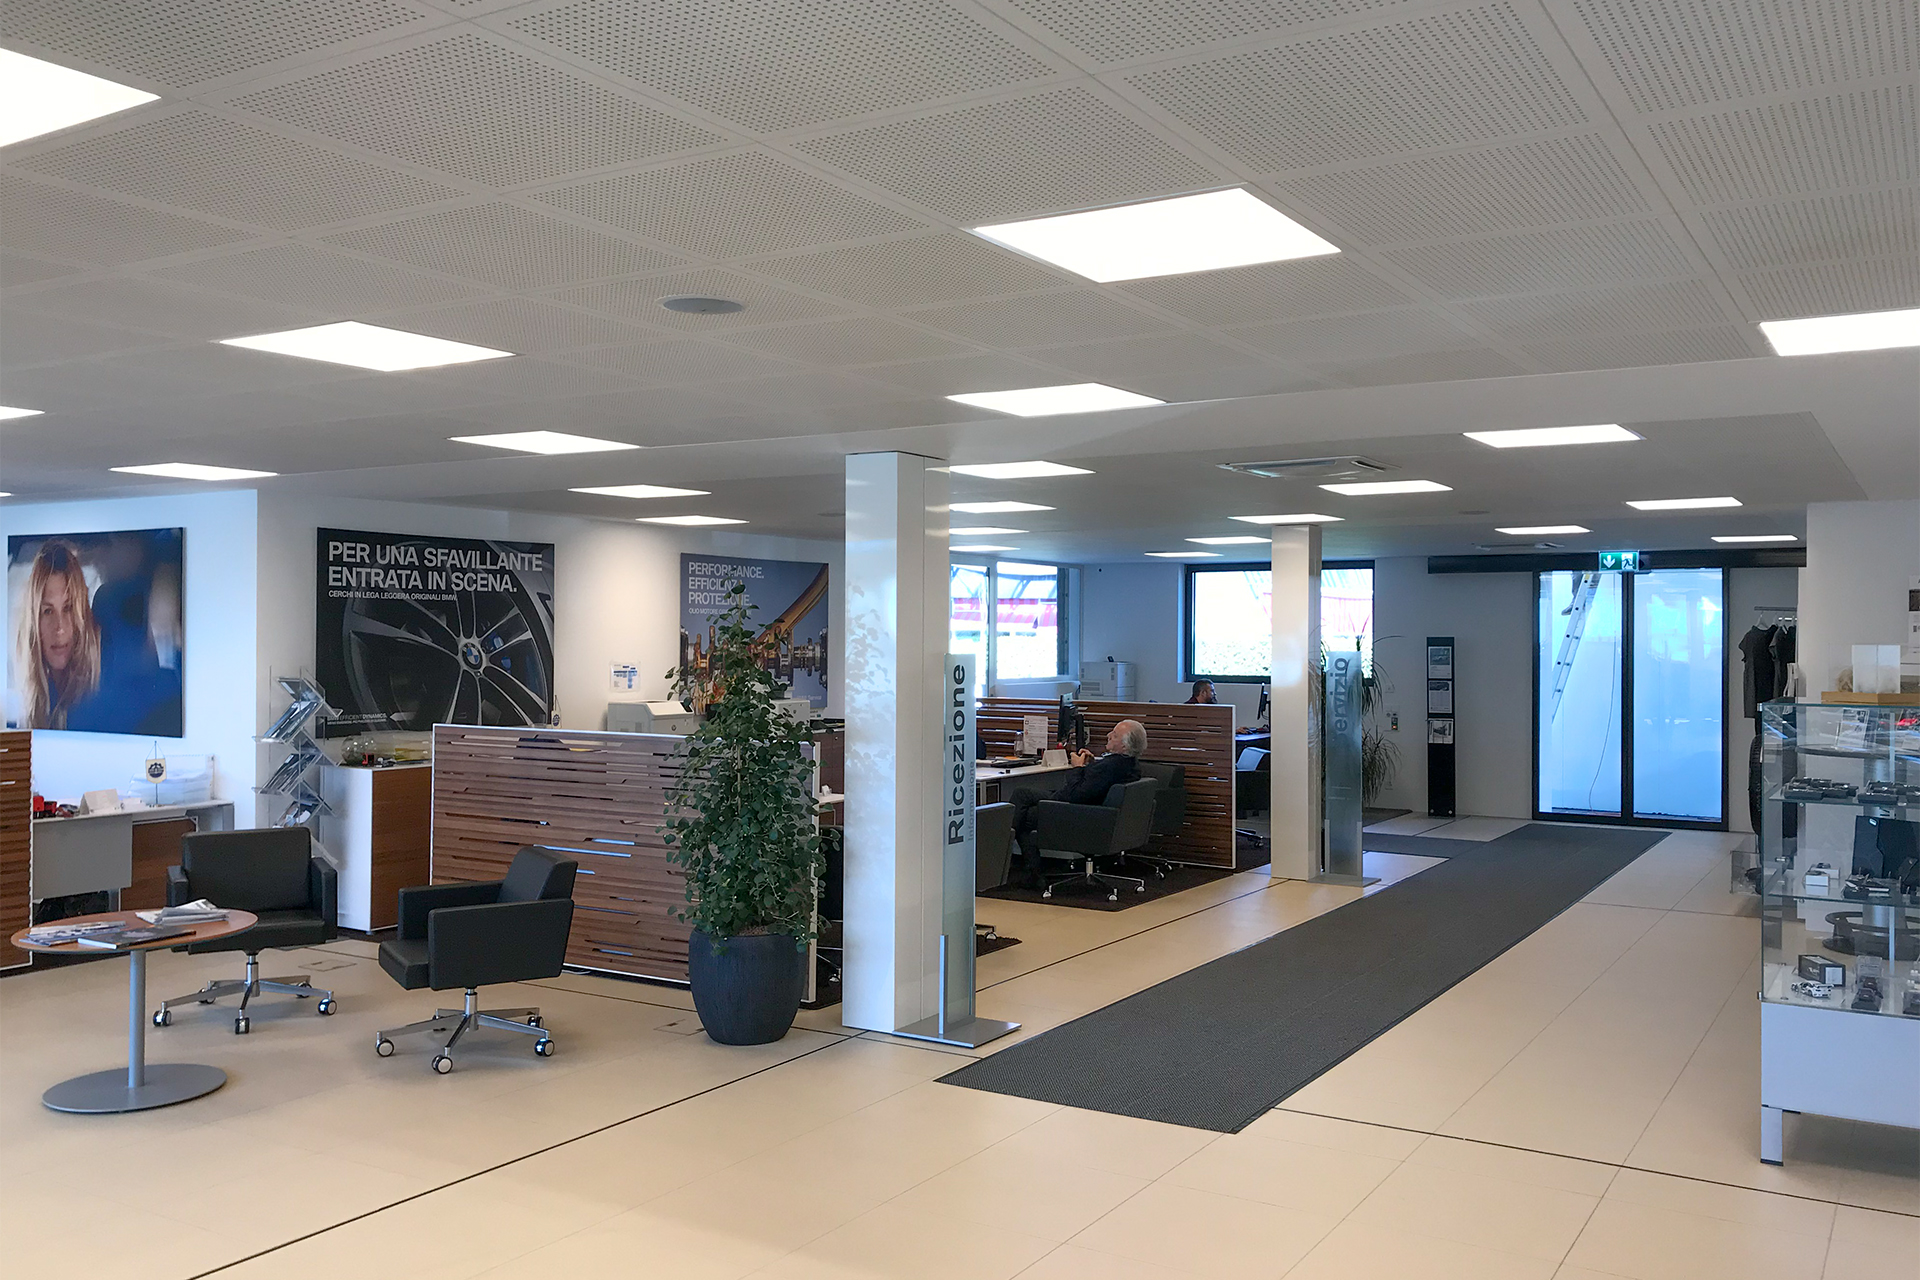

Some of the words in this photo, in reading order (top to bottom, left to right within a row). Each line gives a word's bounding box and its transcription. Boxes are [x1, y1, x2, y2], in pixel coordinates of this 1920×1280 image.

[328, 541, 370, 564] PER
[376, 544, 419, 566] UNA
[423, 547, 543, 572] SFAVILLANTE
[688, 561, 765, 579] PERFORMANCE.
[328, 566, 423, 590] ENTRATA
[427, 570, 446, 591] IN
[450, 572, 518, 593] SCENA.
[328, 590, 353, 598] CERCHI
[380, 592, 410, 600] LEGGERA
[948, 664, 965, 845] Ricezione
[967, 761, 975, 842] Informazione
